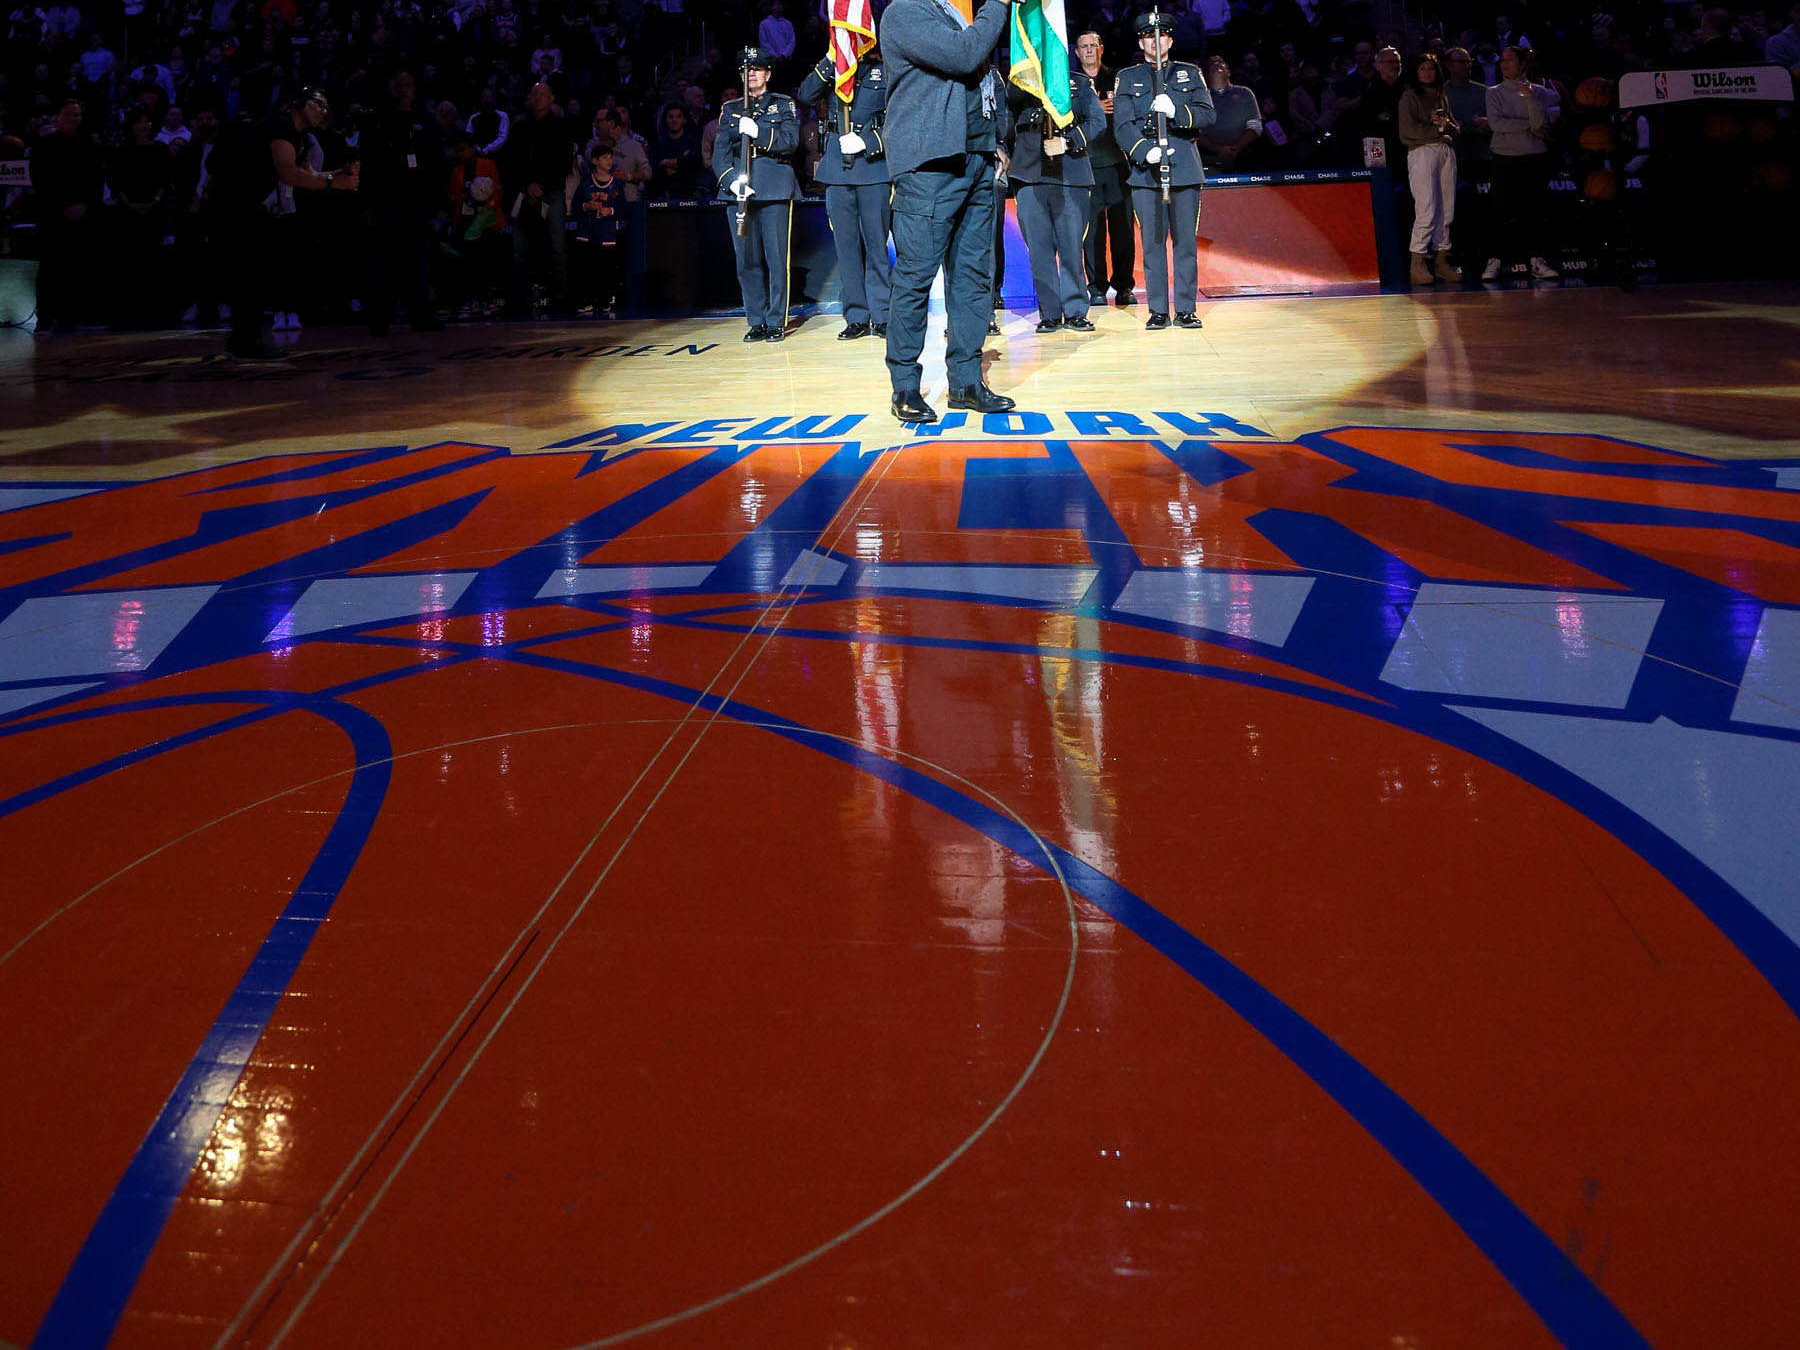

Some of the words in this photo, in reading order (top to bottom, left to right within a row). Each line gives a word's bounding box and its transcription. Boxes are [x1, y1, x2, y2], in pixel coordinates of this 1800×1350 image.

[1691, 71, 1755, 88] Wilson
[1217, 176, 1238, 184] CHASE
[1251, 175, 1271, 183] CHASE
[1284, 173, 1305, 181] CHASE
[1317, 171, 1339, 180] CHASE
[1351, 170, 1372, 178] CHASE
[1561, 261, 1587, 270] HUB
[440, 343, 719, 361] GARDEN
[546, 413, 871, 450] NEW
[896, 412, 1276, 440] YORK
